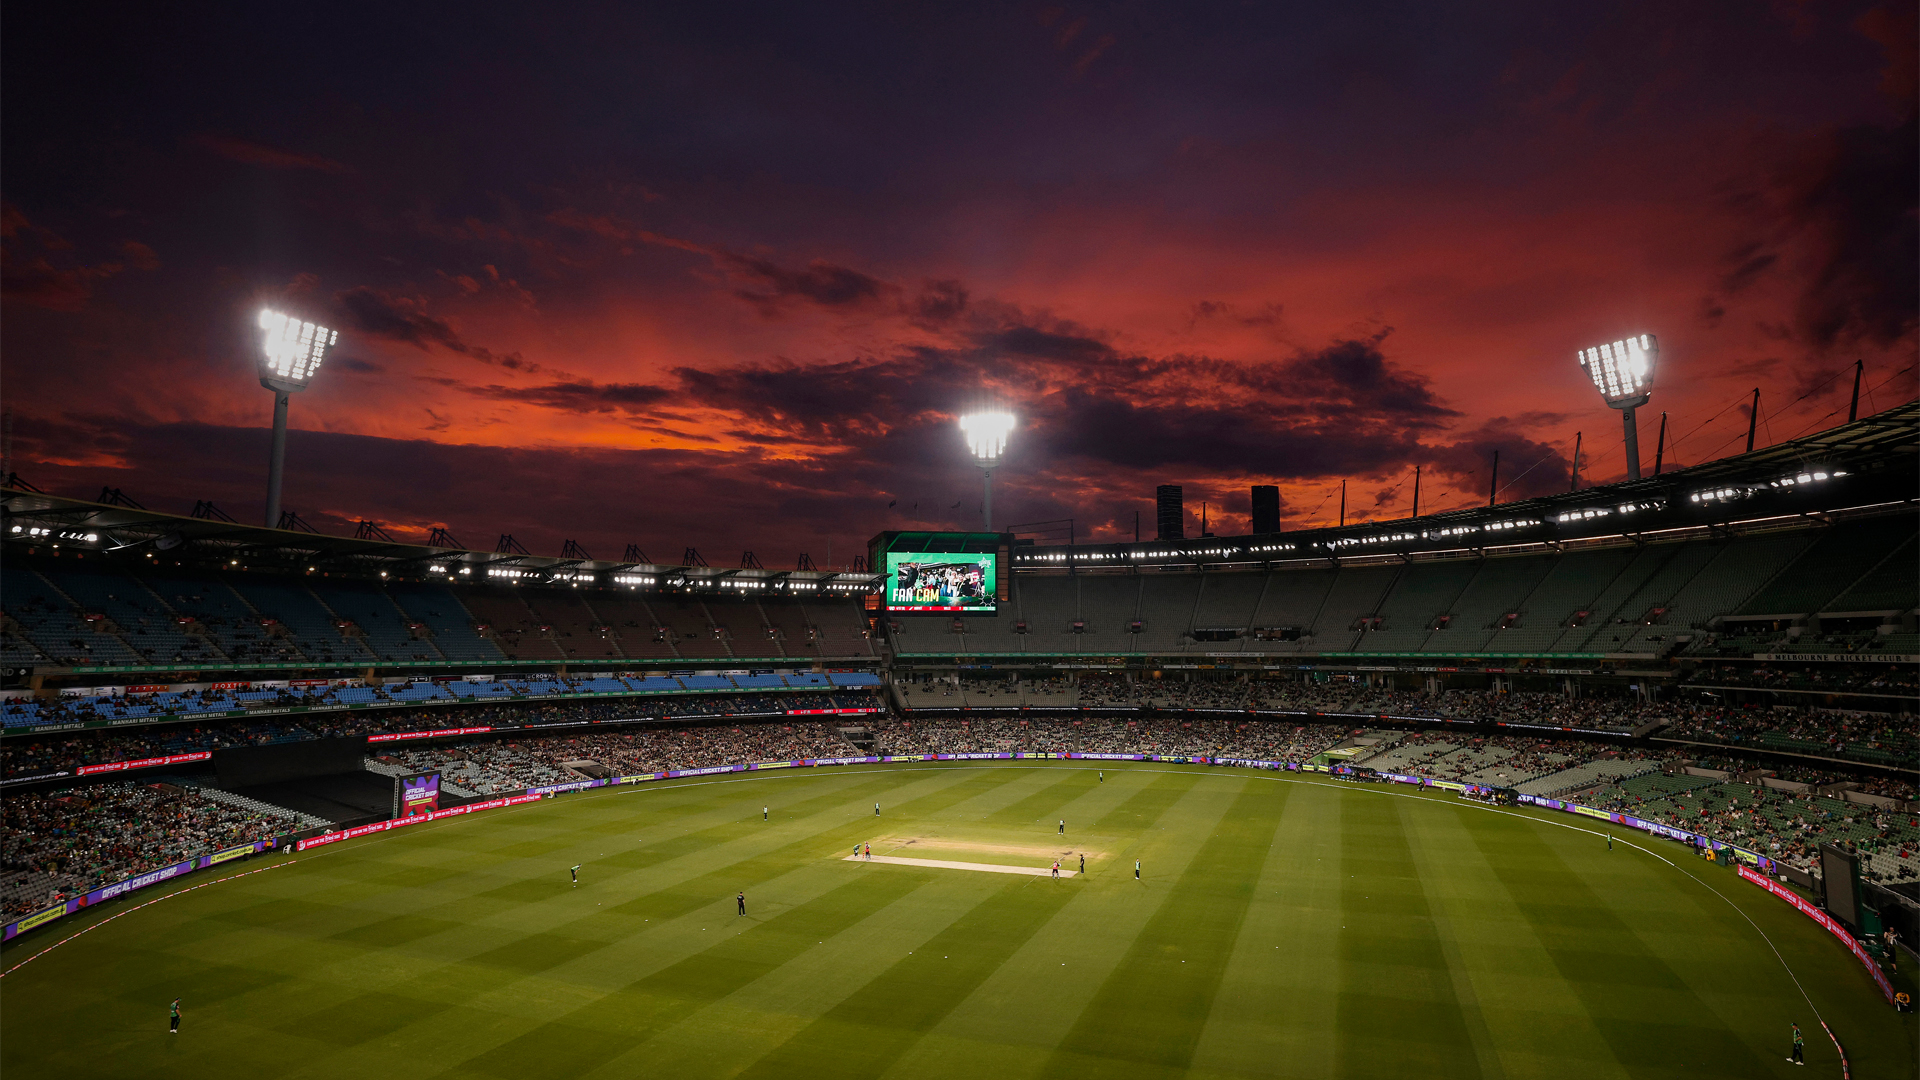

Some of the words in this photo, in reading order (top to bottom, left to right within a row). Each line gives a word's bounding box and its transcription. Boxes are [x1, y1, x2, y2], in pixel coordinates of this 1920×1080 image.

[280, 397, 288, 408] 4
[1624, 412, 1630, 420] 6
[892, 589, 913, 602] FAN
[916, 589, 939, 602] CAM
[35, 723, 62, 732] MANHARI
[406, 787, 425, 795] OFFICIAL
[405, 793, 424, 801] CRICKET
[132, 873, 160, 888] CRICKET
[160, 867, 177, 879] SHOP
